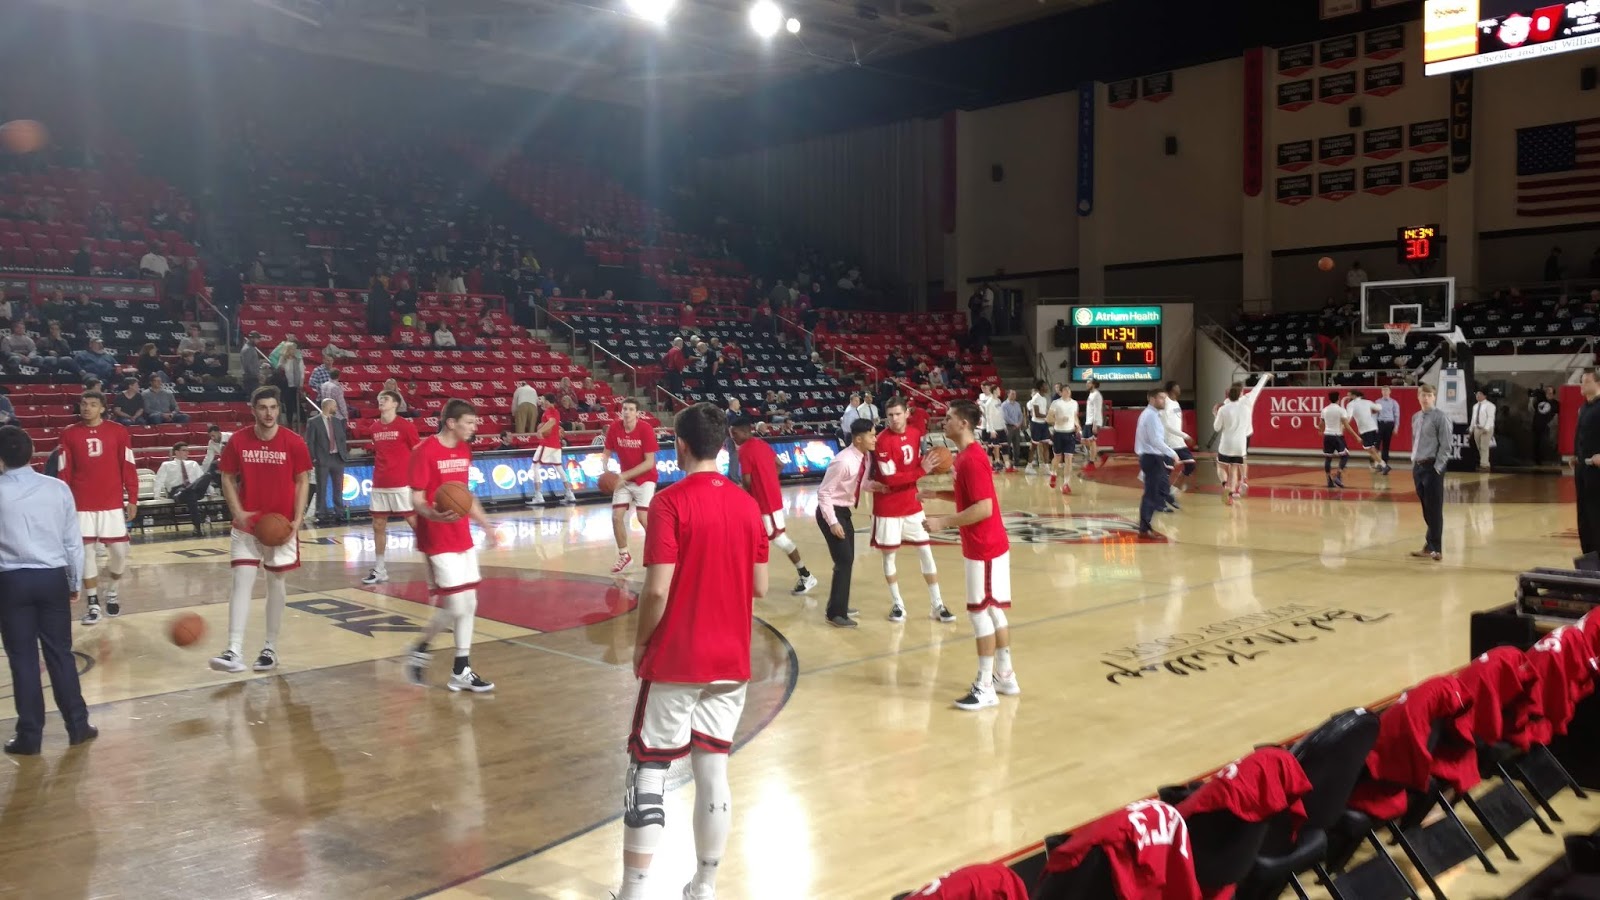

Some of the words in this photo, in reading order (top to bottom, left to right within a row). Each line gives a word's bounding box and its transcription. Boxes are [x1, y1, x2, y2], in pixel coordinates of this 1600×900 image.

[1518, 46, 1535, 57] and
[1406, 239, 1429, 258] 30
[1095, 312, 1128, 321] Atrium
[1129, 311, 1159, 321] Health
[1103, 327, 1136, 341] 14:34
[1080, 342, 1107, 350] DAVIDSON
[1126, 342, 1153, 350] RICHMOND
[1091, 350, 1100, 363] 0
[1116, 351, 1121, 362] 1
[1145, 349, 1154, 362] 0
[1270, 416, 1321, 429] COU
[86, 437, 103, 457] D
[242, 450, 287, 460] DAVIDSON
[901, 444, 914, 465] D
